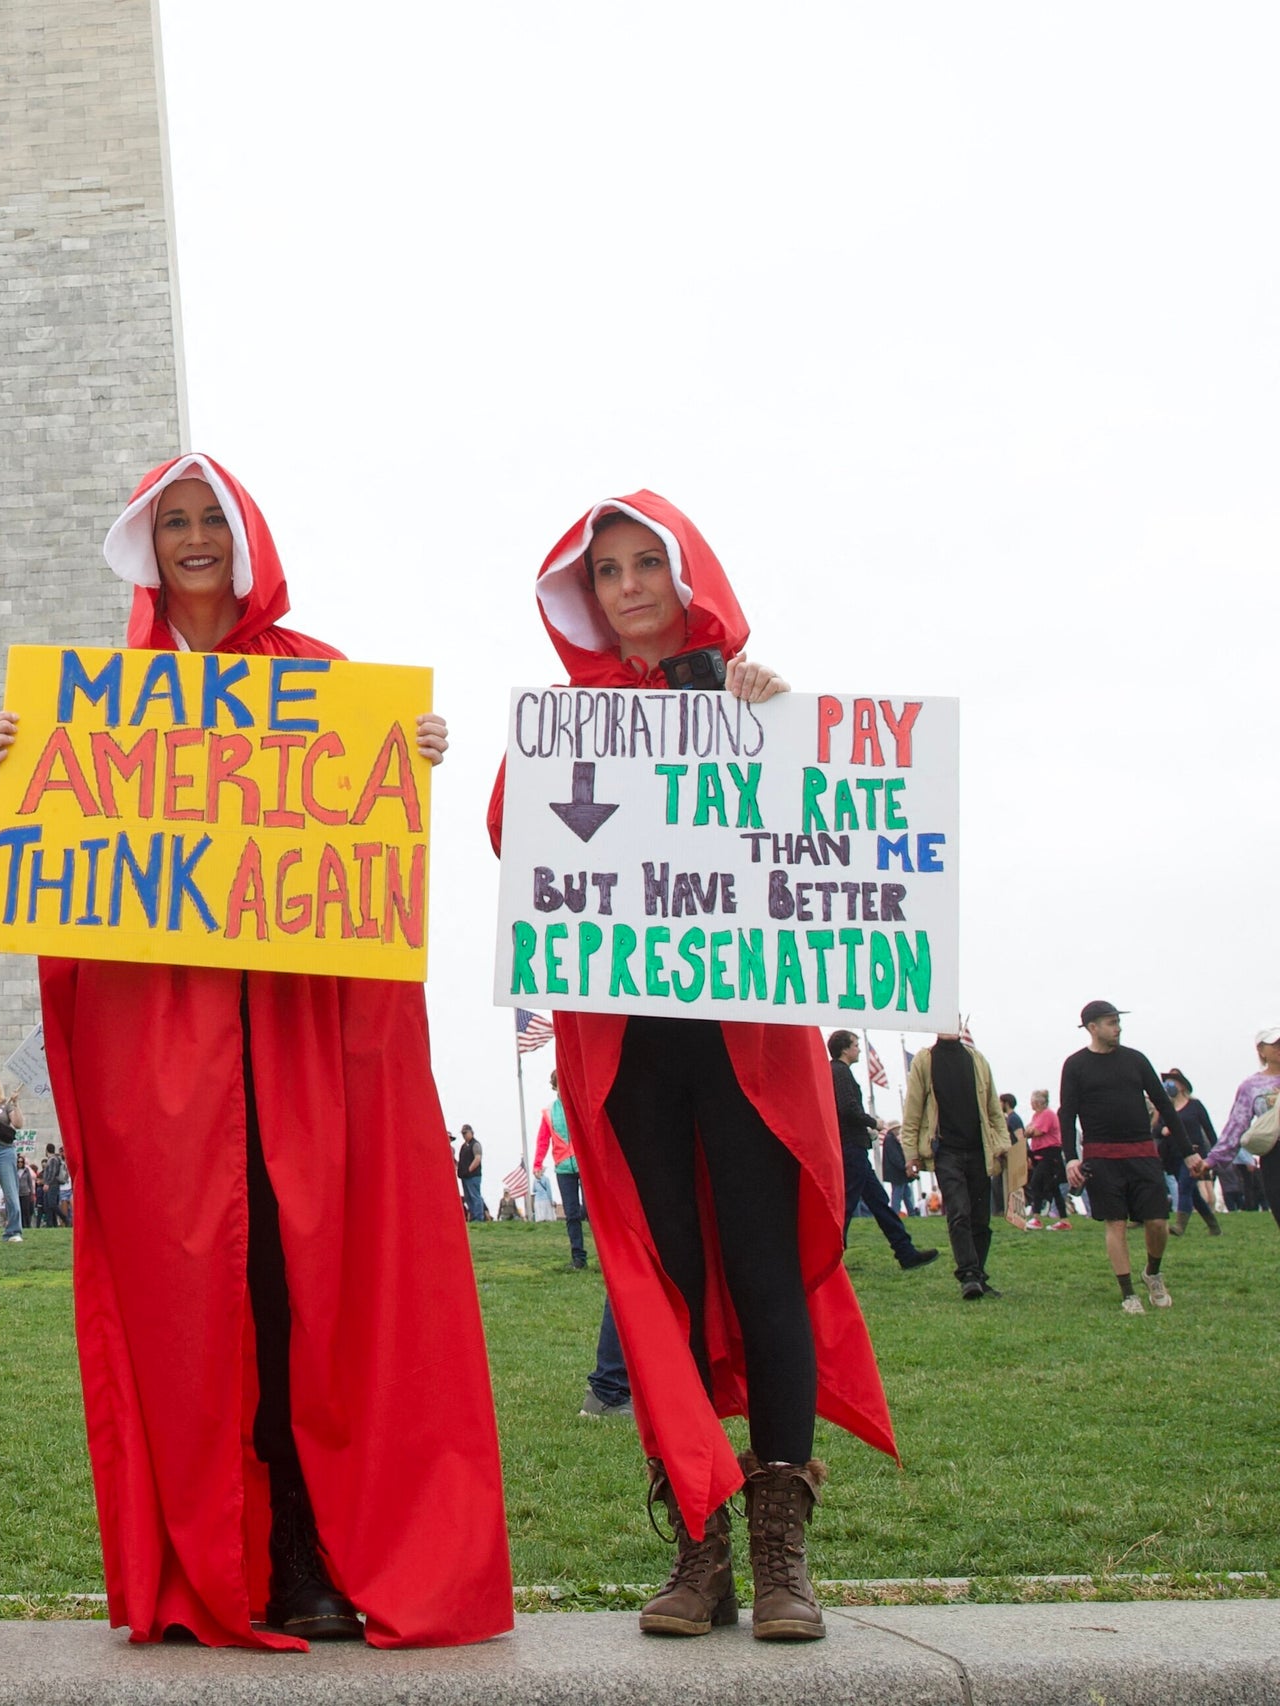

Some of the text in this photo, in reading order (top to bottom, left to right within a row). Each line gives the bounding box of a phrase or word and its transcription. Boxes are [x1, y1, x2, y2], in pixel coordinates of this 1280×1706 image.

[57, 650, 331, 733] MAKE
[516, 691, 923, 767] CORPORATIONS PAY
[15, 720, 423, 832] AMERICA
[655, 762, 908, 835] TAX RATE
[532, 862, 907, 921] BUT HAVE BETTER
[740, 832, 946, 873] THAN ME
[224, 837, 426, 949] AGAIN
[510, 921, 932, 1013] REPRESENATION
